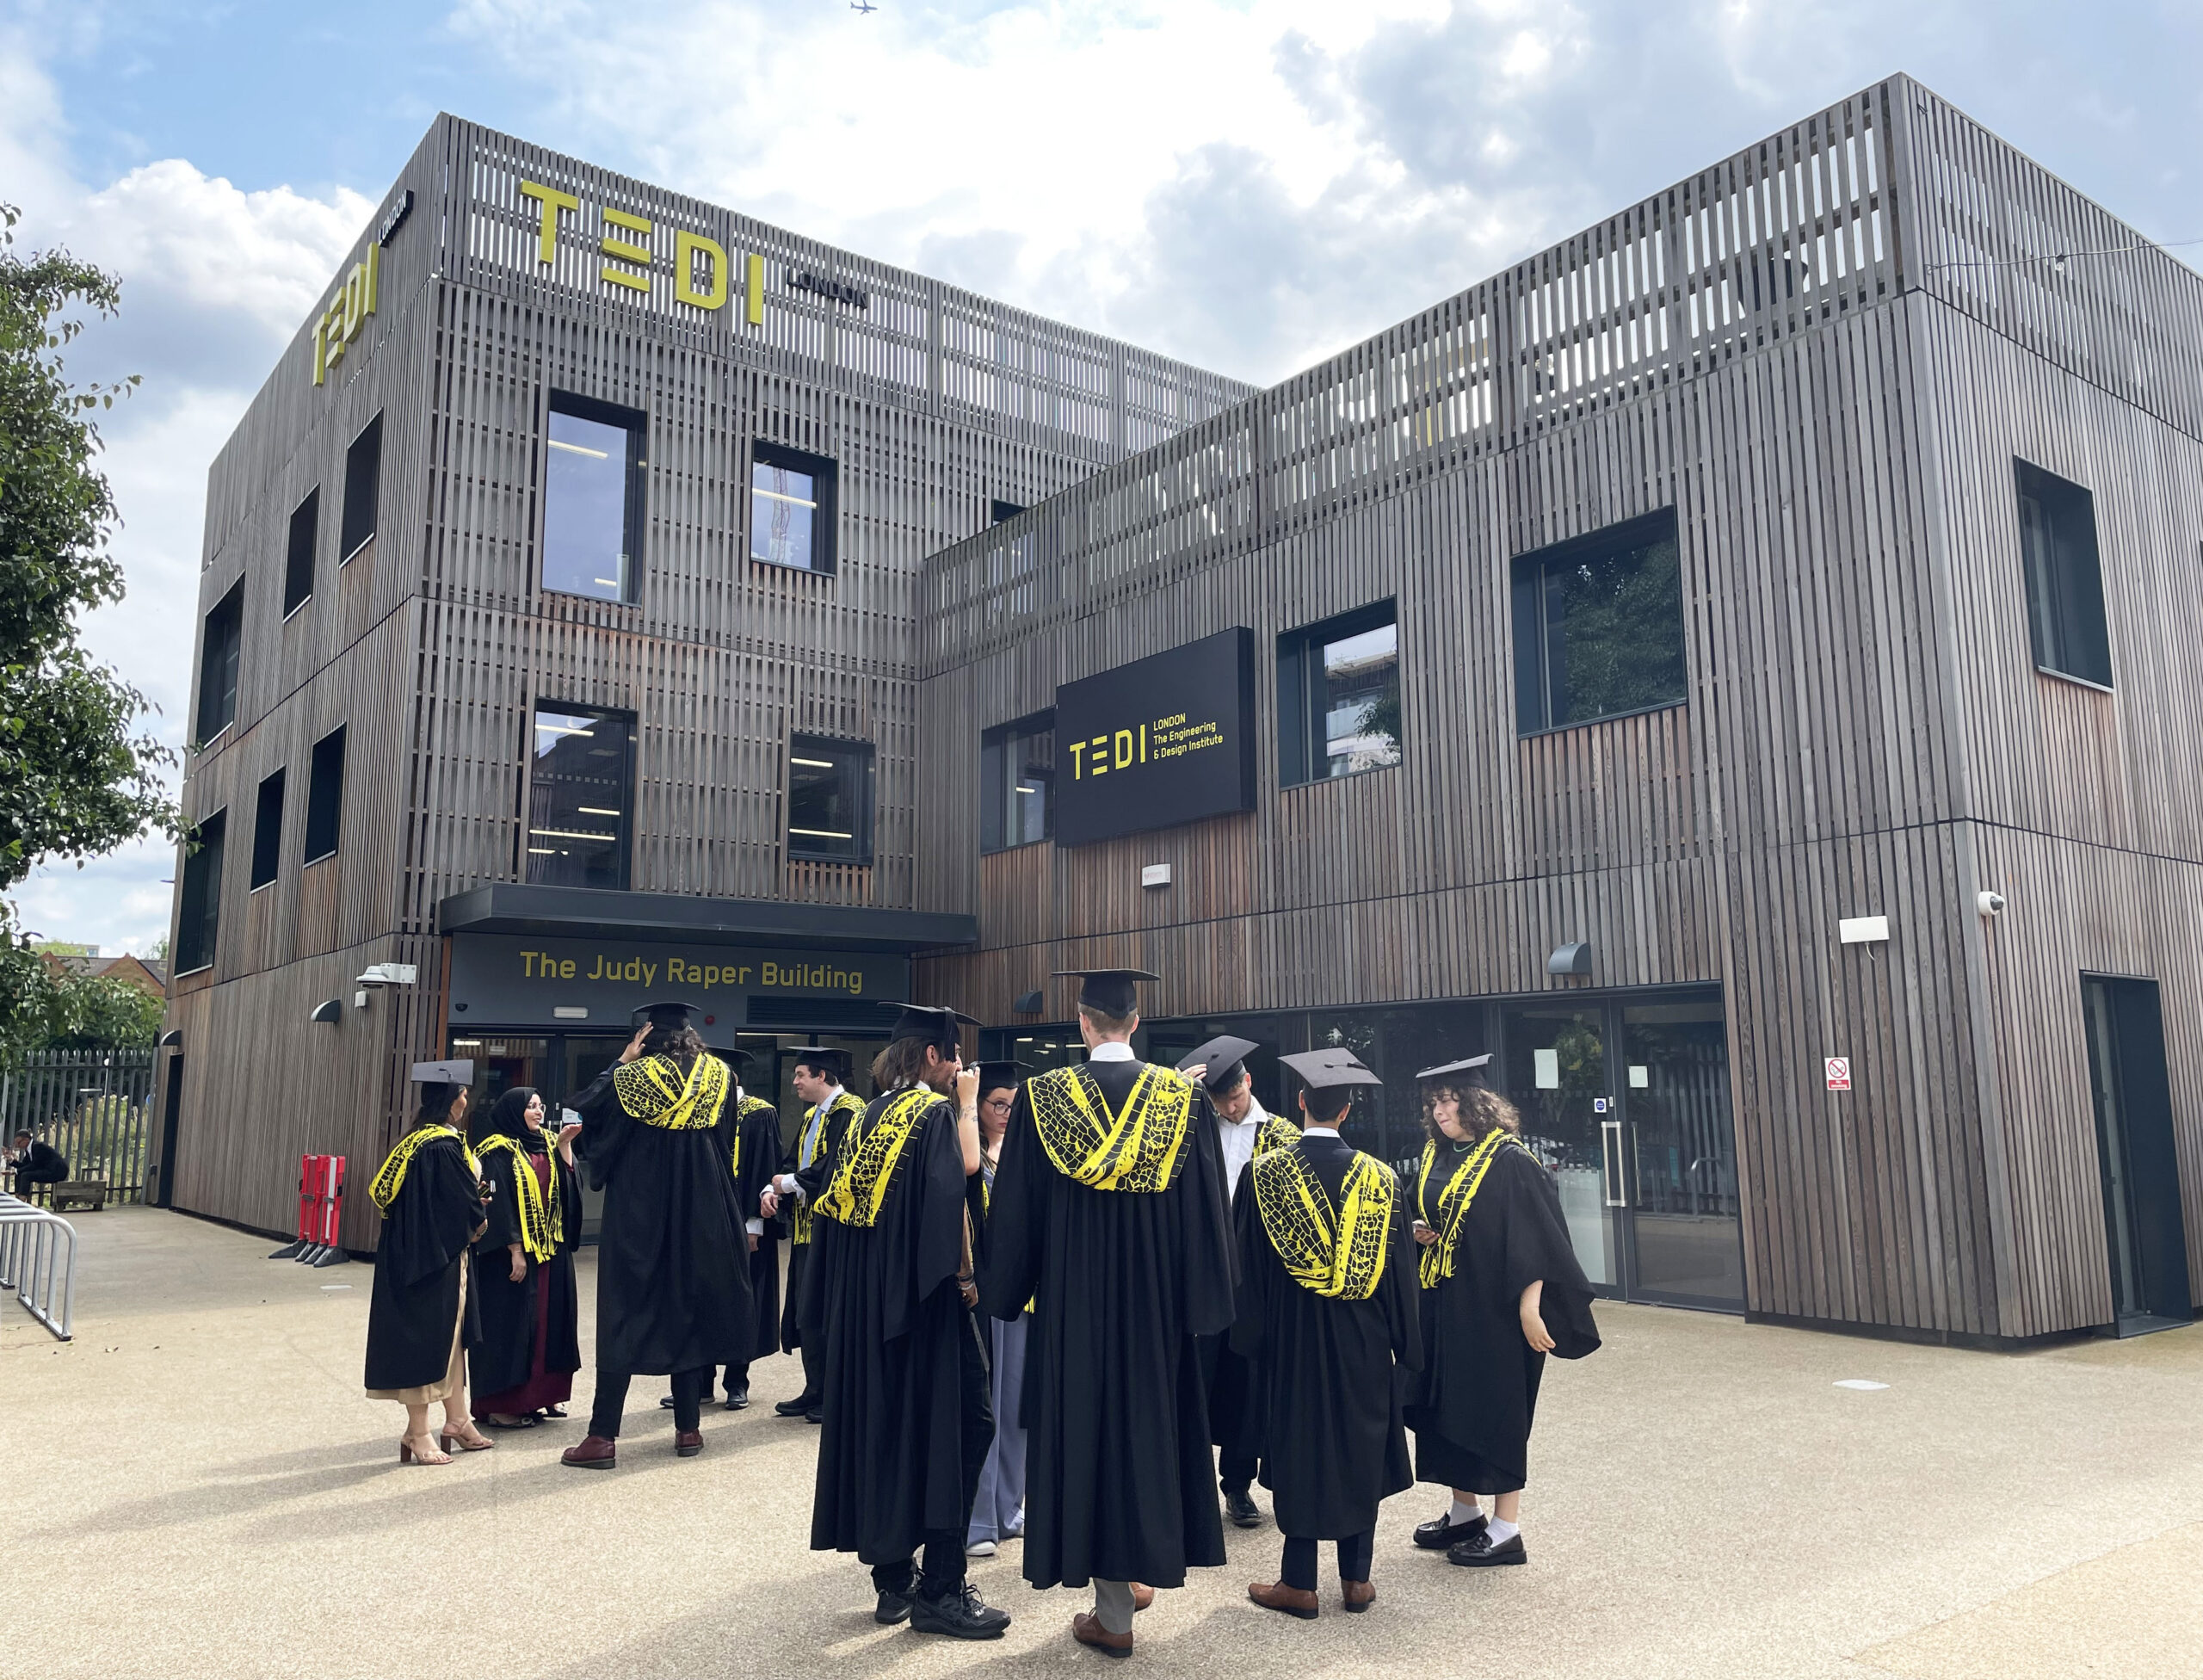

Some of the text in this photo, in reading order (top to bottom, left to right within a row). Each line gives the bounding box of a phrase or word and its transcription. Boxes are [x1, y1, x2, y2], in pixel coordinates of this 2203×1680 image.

[520, 180, 868, 326] TEDI LONDON
[312, 189, 414, 387] TEDI LONDON
[1153, 713, 1186, 731] LONDON
[1153, 722, 1216, 745] The Engineering
[1070, 724, 1145, 781] TEDI
[1161, 744, 1188, 757] Design
[1188, 734, 1223, 750] Institute
[520, 951, 863, 994] The Judy Raper Building
